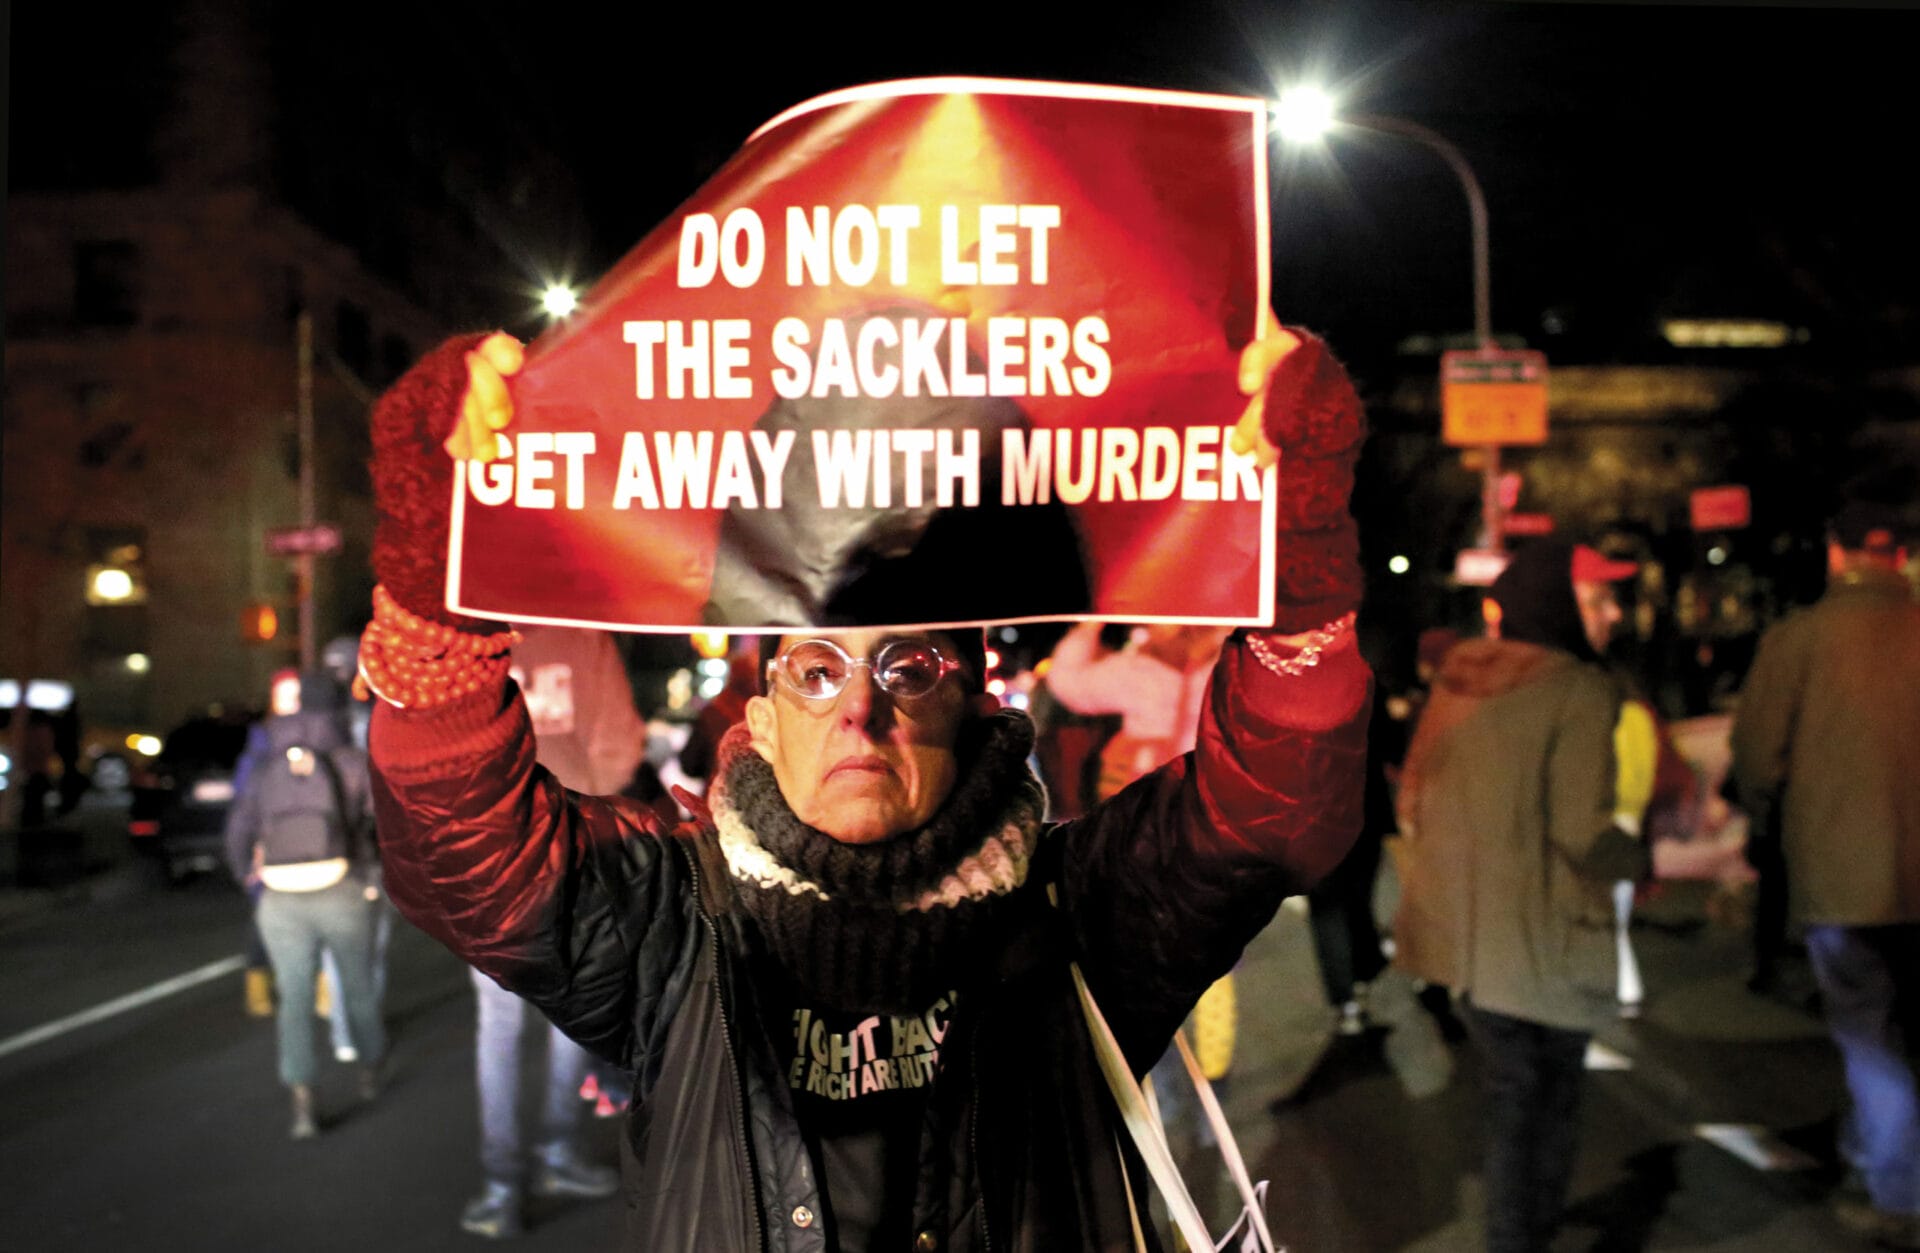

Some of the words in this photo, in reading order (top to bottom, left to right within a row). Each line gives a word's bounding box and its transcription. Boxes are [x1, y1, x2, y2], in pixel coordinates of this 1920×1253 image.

[677, 208, 765, 288] DO
[786, 205, 920, 286] NOT
[941, 205, 1060, 285] LET
[623, 320, 752, 398] THE
[771, 316, 1111, 398] SACKLERS
[468, 432, 596, 509] GET
[612, 430, 796, 509] AWAY
[811, 429, 979, 508] WITH
[1002, 426, 1262, 502] MURDER
[891, 990, 957, 1057] BAC
[806, 1060, 857, 1100] RICH
[861, 1058, 899, 1095] ARE
[900, 1050, 945, 1088] RUT
